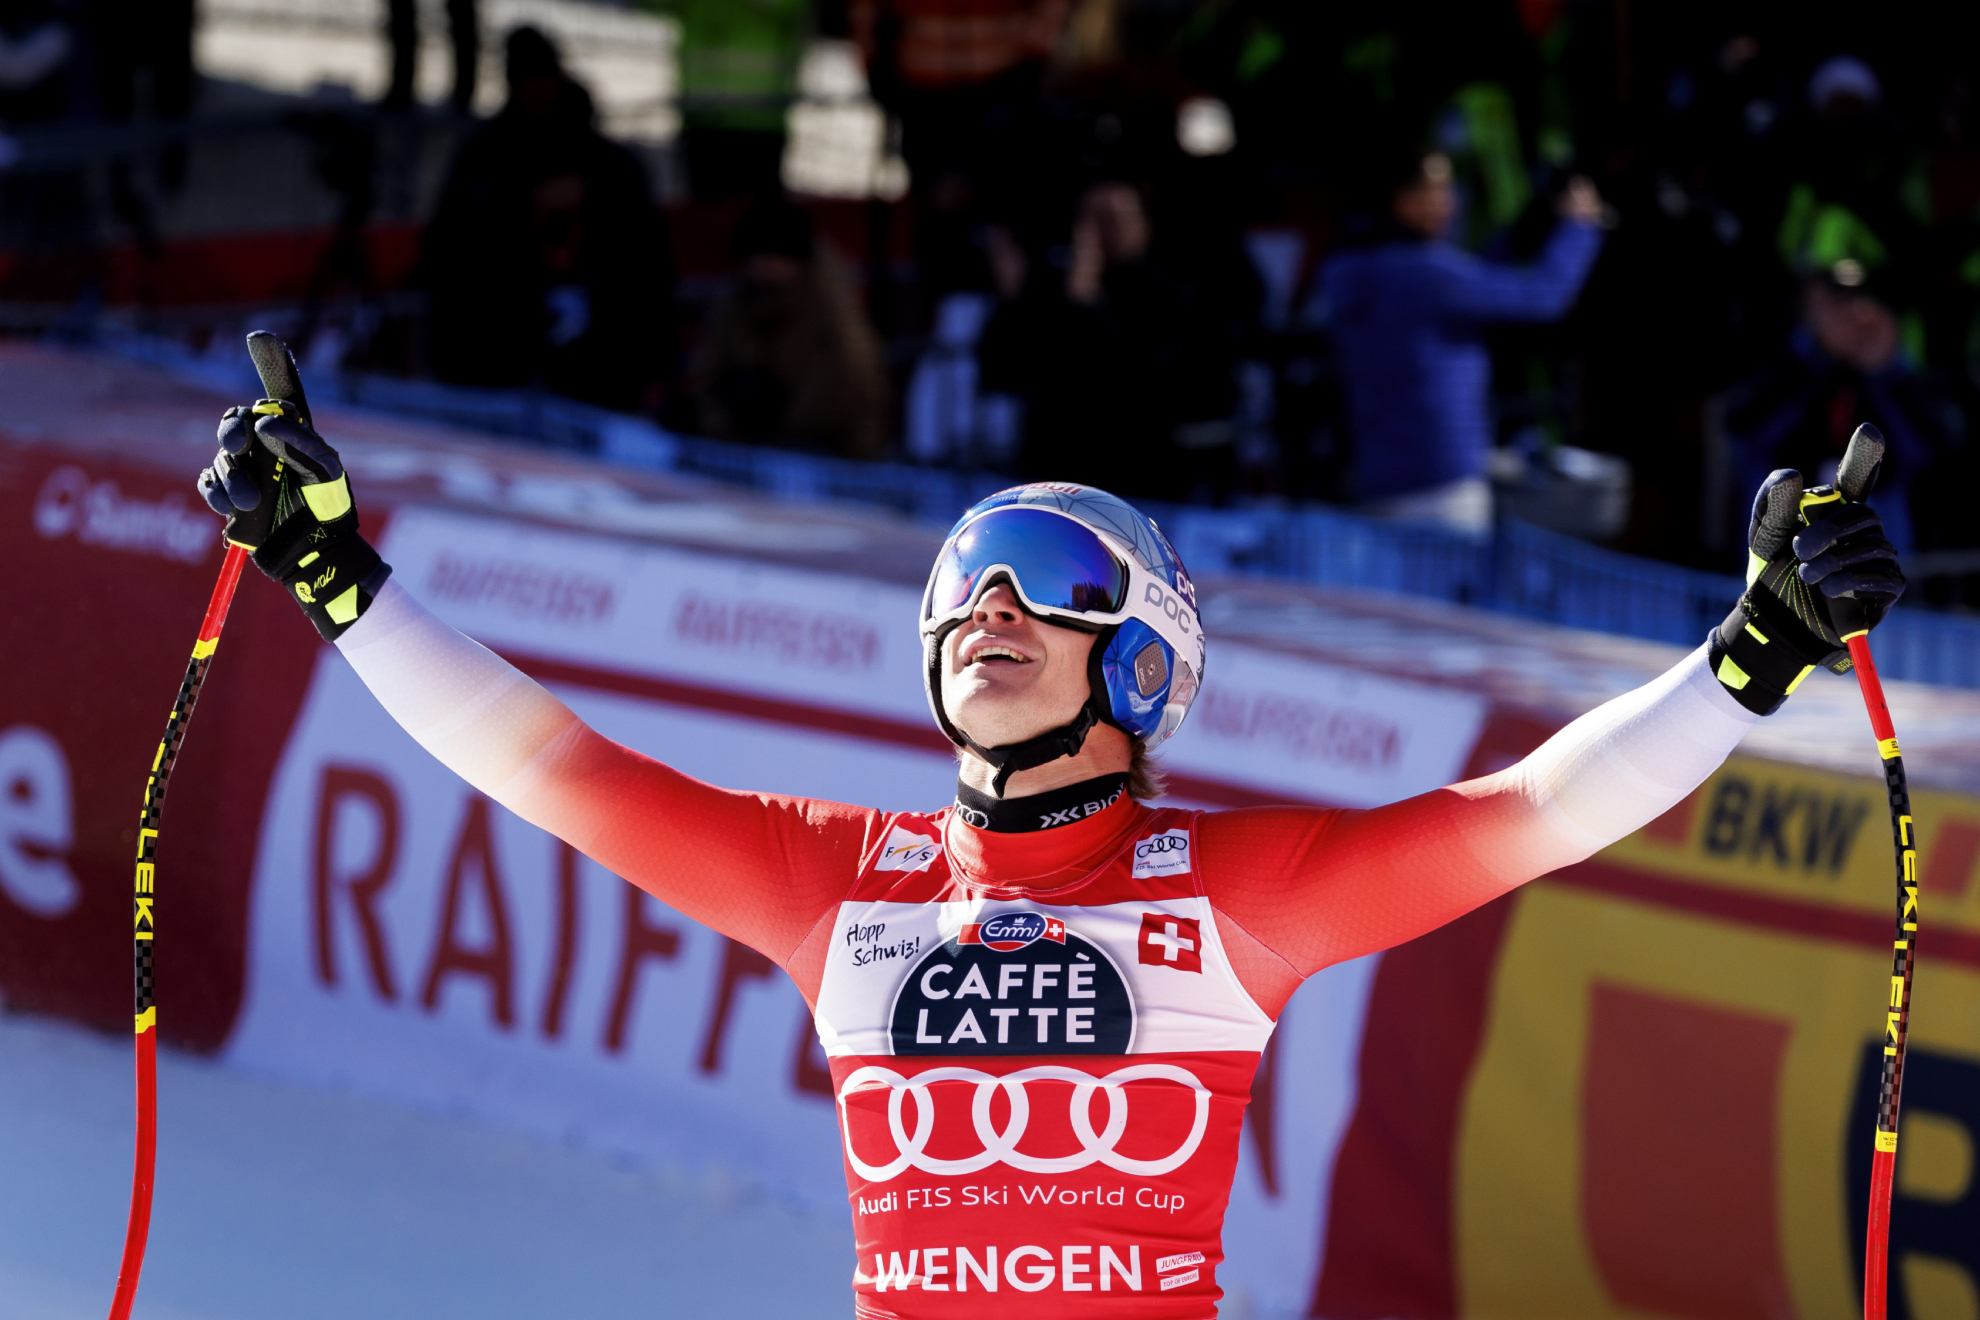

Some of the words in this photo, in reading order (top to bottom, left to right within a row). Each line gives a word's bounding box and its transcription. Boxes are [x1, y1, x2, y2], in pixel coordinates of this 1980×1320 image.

[1144, 582, 1191, 634] poc
[1705, 776, 1870, 876] BKW
[135, 827, 158, 940] LEKI
[1900, 815, 1917, 932] LEKI
[847, 923, 885, 946] Hopp
[852, 936, 920, 967] Schwiz!
[985, 920, 1040, 938] Emmi
[920, 953, 1096, 999] CAFFÈ
[916, 1008, 1095, 1044] LATTE
[858, 1192, 898, 1216] Audi
[907, 1187, 952, 1209] FIS
[961, 1185, 1008, 1206] Ski
[1018, 1185, 1124, 1206] World
[1135, 1188, 1185, 1214] Cup
[875, 1245, 1143, 1293] WENGEN
